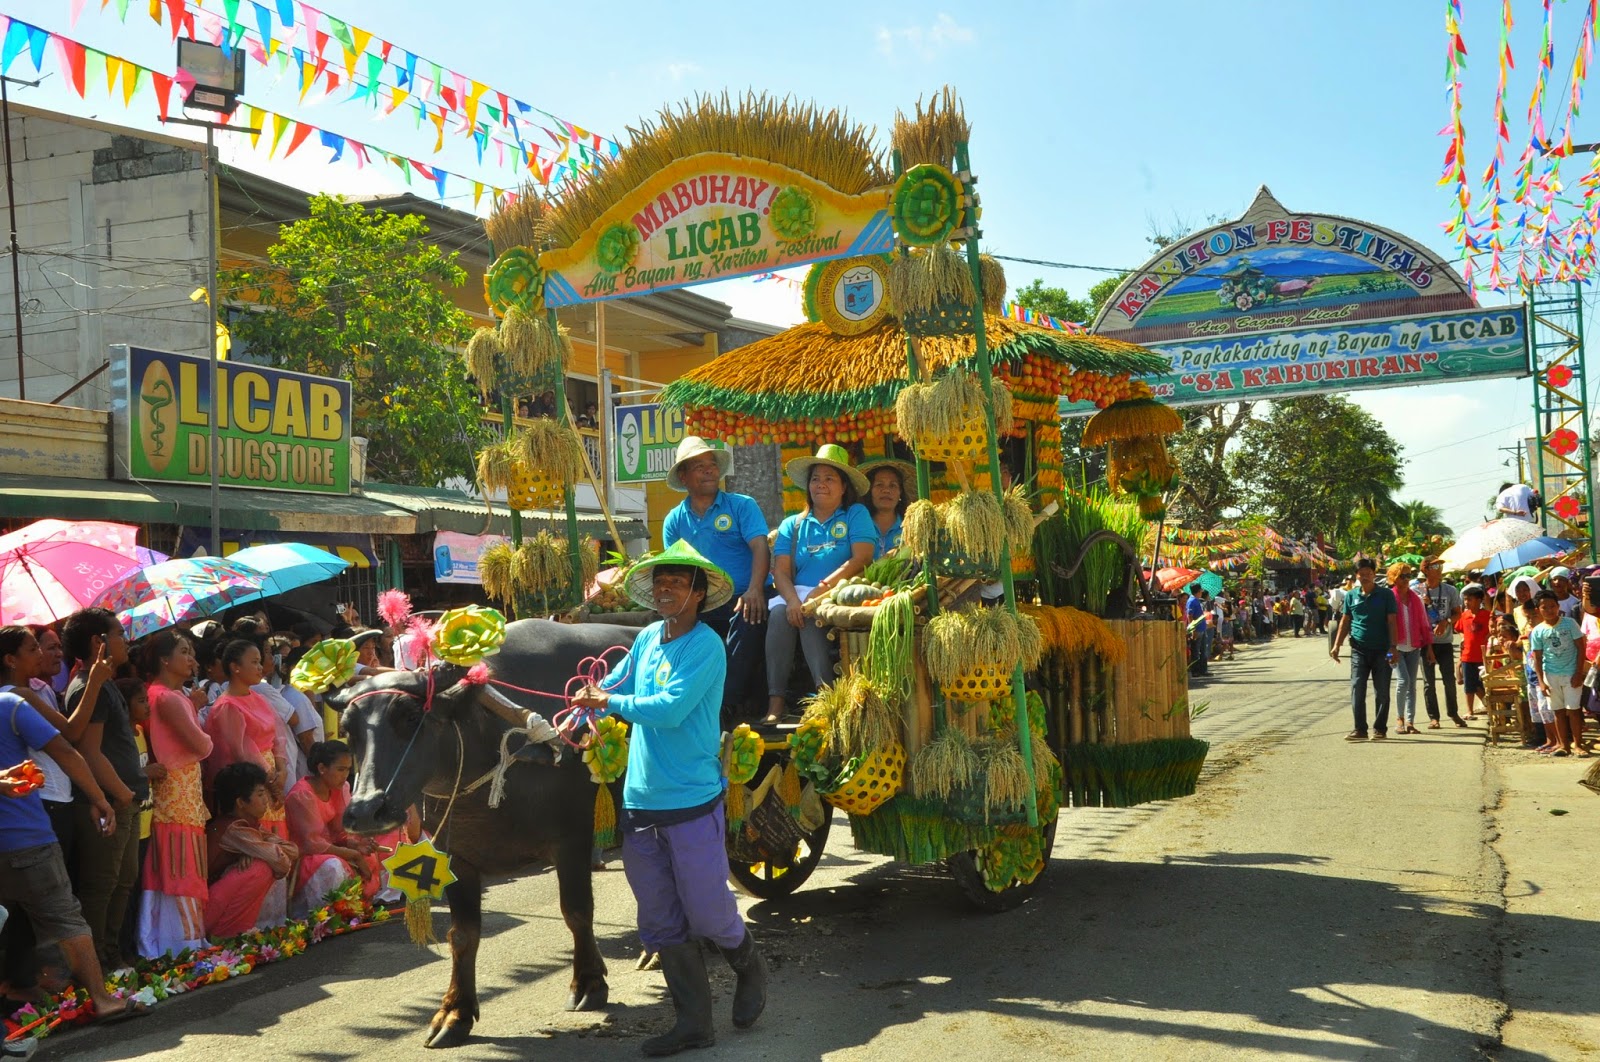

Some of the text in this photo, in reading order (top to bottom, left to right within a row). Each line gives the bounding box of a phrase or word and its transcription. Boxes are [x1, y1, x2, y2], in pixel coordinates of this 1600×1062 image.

[631, 174, 781, 243] MABUHAY!
[665, 212, 761, 261] LICAB
[584, 231, 842, 297] Ang Bayan ng Kariton Festival
[1116, 219, 1432, 320] KARITON FESTIVAL
[1181, 339, 1300, 369] Pagkakatatag
[1309, 340, 1329, 359] ng
[1337, 332, 1391, 353] Bayan
[1399, 330, 1421, 350] ng
[1429, 316, 1516, 343] LICAB
[1235, 315, 1296, 329] Bagong
[179, 361, 343, 441] LICAB
[188, 432, 335, 486] DRUGSTORE
[392, 855, 441, 891] 4
